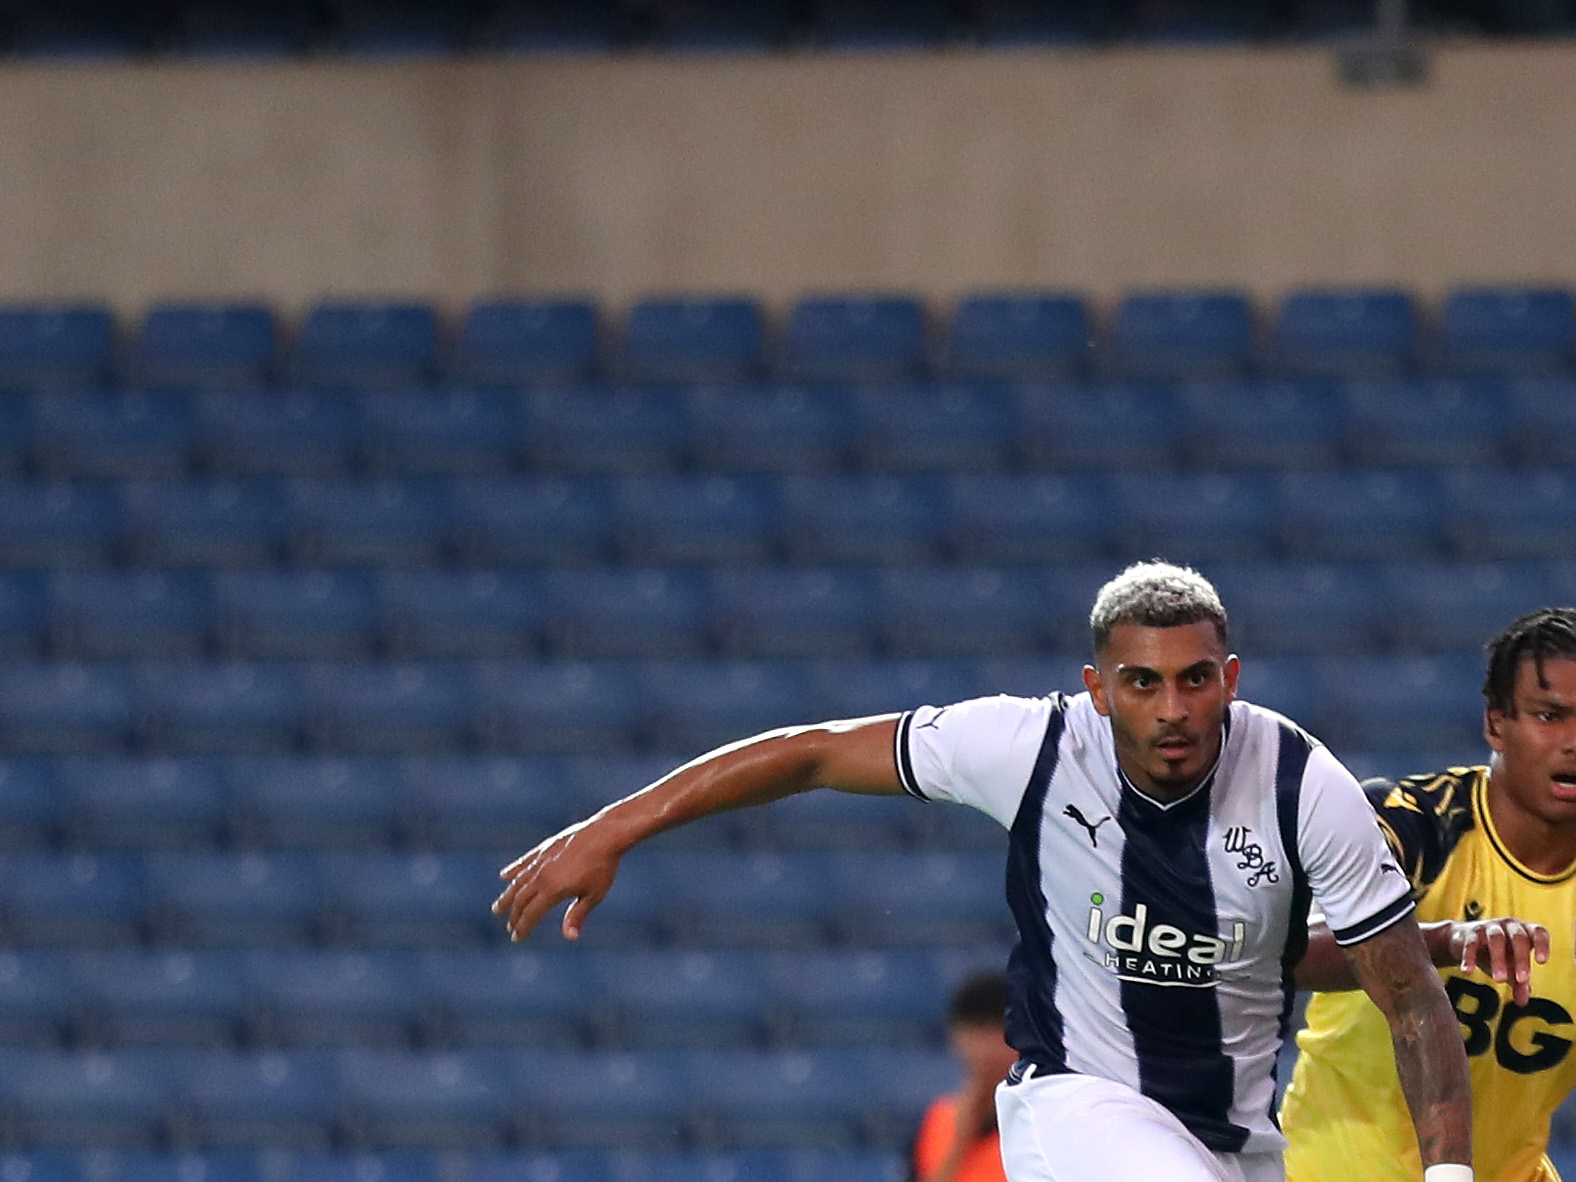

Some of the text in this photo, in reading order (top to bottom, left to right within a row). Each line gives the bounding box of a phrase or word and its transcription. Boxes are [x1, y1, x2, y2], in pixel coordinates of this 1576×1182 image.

[1222, 825, 1279, 887] WBA
[1086, 892, 1246, 965] ideal
[1104, 952, 1222, 980] HEATIN
[1444, 974, 1574, 1075] BG
